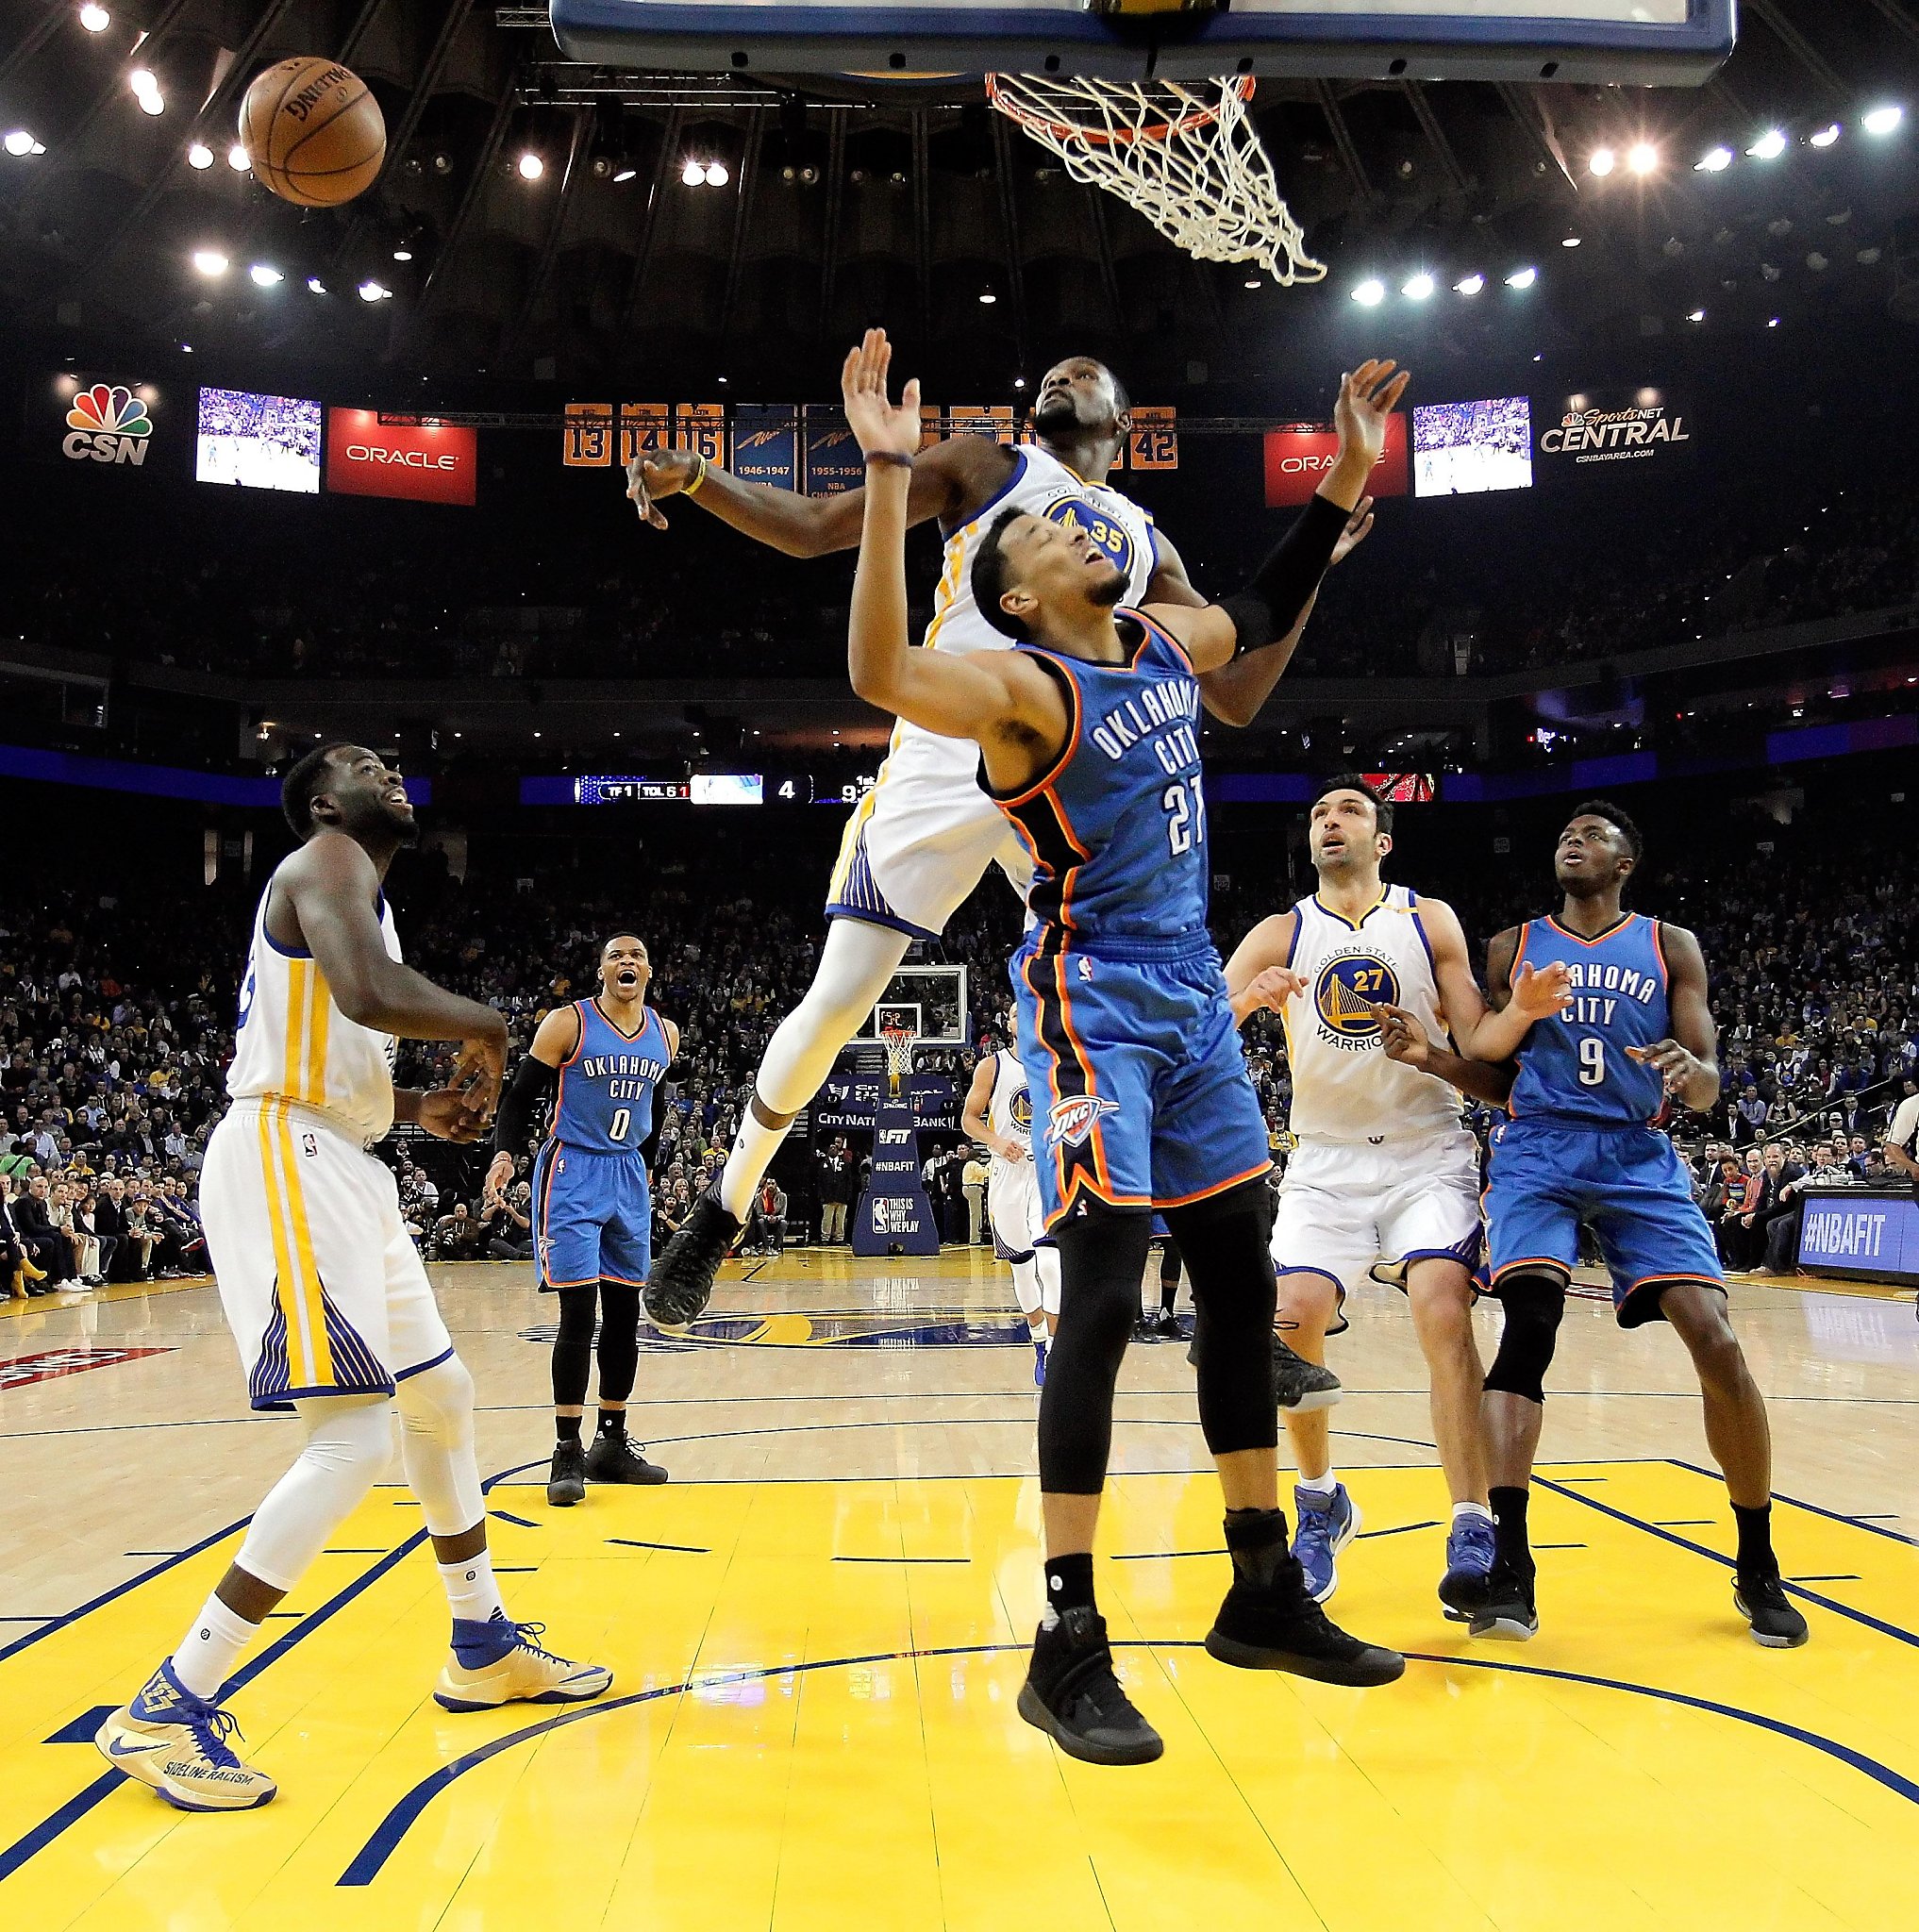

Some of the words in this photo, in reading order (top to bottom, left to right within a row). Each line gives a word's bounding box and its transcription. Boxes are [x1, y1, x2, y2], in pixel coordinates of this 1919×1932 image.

[285, 66, 352, 122] PALDING
[62, 431, 149, 465] CSN
[572, 427, 605, 458] 13
[629, 428, 659, 459] 14
[685, 429, 717, 460] 16
[1135, 431, 1175, 462] 42
[1541, 417, 1690, 453] CENTRAL
[345, 444, 456, 471] ORACLE
[1576, 449, 1655, 463] CSNBAYAREA.COM
[739, 466, 790, 475] 1946-1947
[811, 467, 862, 475] 1955-1956
[1090, 520, 1125, 554] 35
[624, 785, 632, 797] 1
[777, 781, 795, 799] 4
[1163, 774, 1205, 857] 21
[1313, 946, 1361, 974] GOLDEN
[1365, 946, 1400, 971] STATE
[1353, 968, 1384, 992] 27
[1569, 963, 1657, 1005] AHOMA
[1560, 996, 1617, 1025] CITY
[1316, 1024, 1383, 1052] WARRIO
[1578, 1038, 1605, 1086] 9
[609, 1079, 645, 1101] CITY
[609, 1108, 631, 1141] 0
[845, 1114, 876, 1126] NATI
[912, 1116, 946, 1128] BANK
[1051, 1103, 1090, 1142] OKC
[875, 1161, 915, 1172] #NBAFIT
[889, 1198, 905, 1210] THIS
[906, 1198, 914, 1210] IS
[890, 1209, 906, 1222] WHY
[891, 1221, 902, 1233] WE
[902, 1220, 920, 1233] PLAY
[1804, 1213, 1886, 1257] #NBAFIT
[163, 1761, 209, 1780] SIDELINE
[206, 1771, 255, 1786] RACISM
